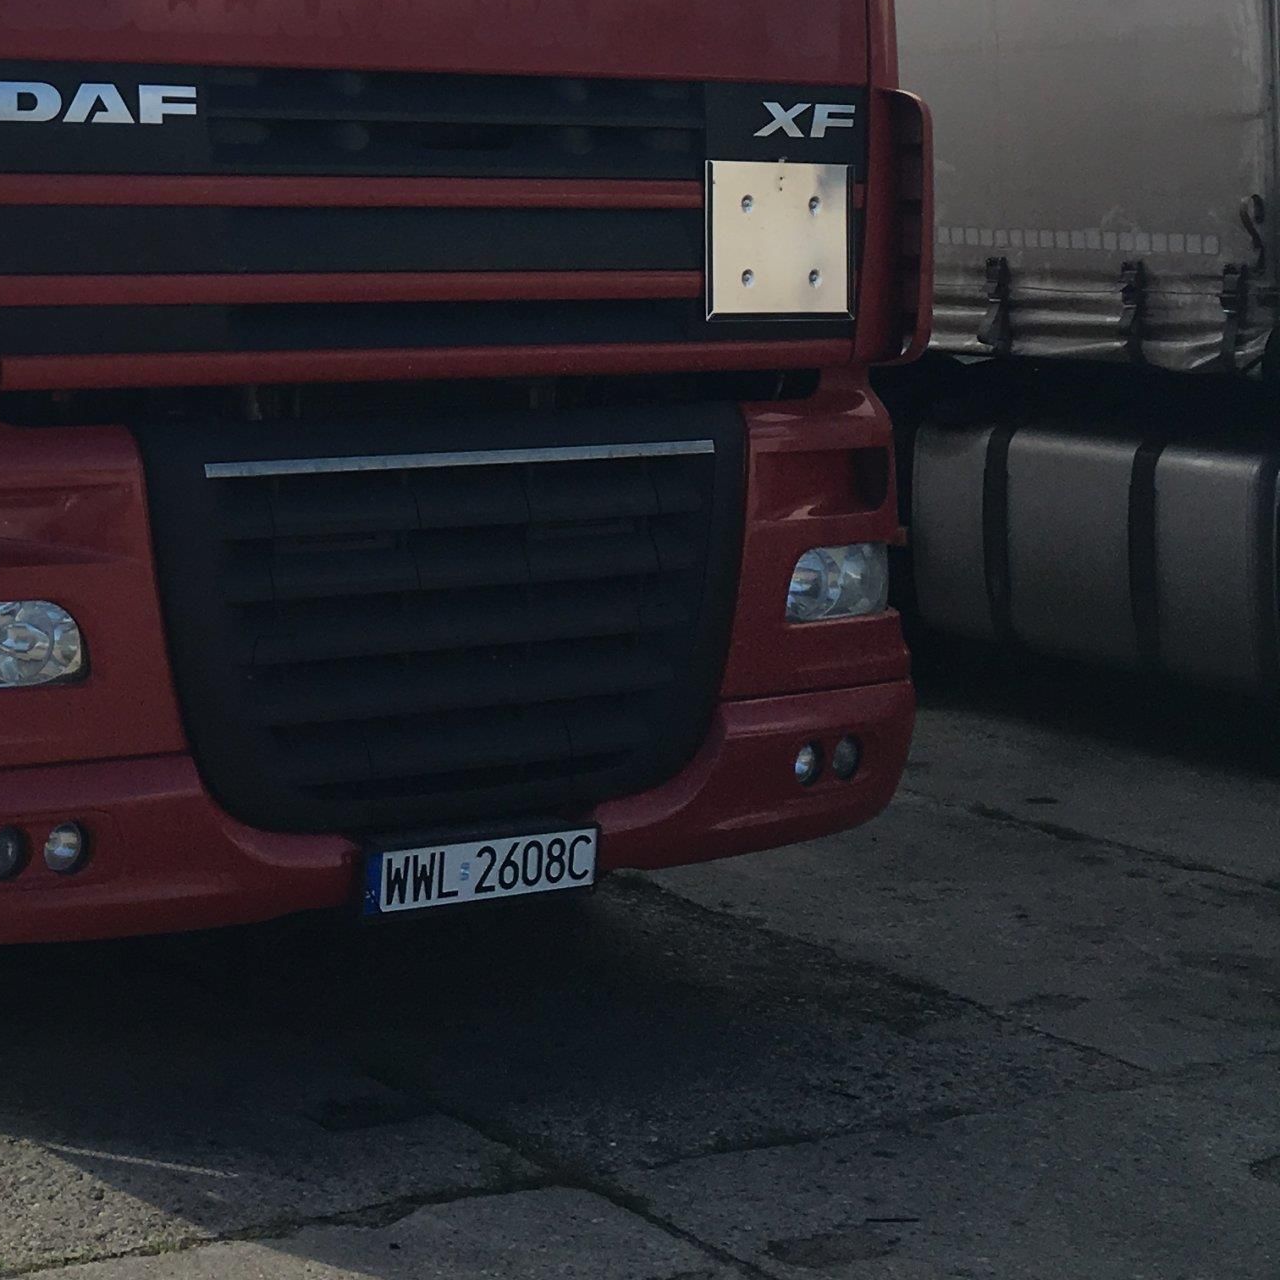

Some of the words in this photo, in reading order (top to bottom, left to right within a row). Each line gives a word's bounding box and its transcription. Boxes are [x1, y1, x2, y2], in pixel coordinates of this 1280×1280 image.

[753, 102, 856, 138] XF
[386, 851, 459, 905] WWL
[474, 835, 593, 894] 2608C
